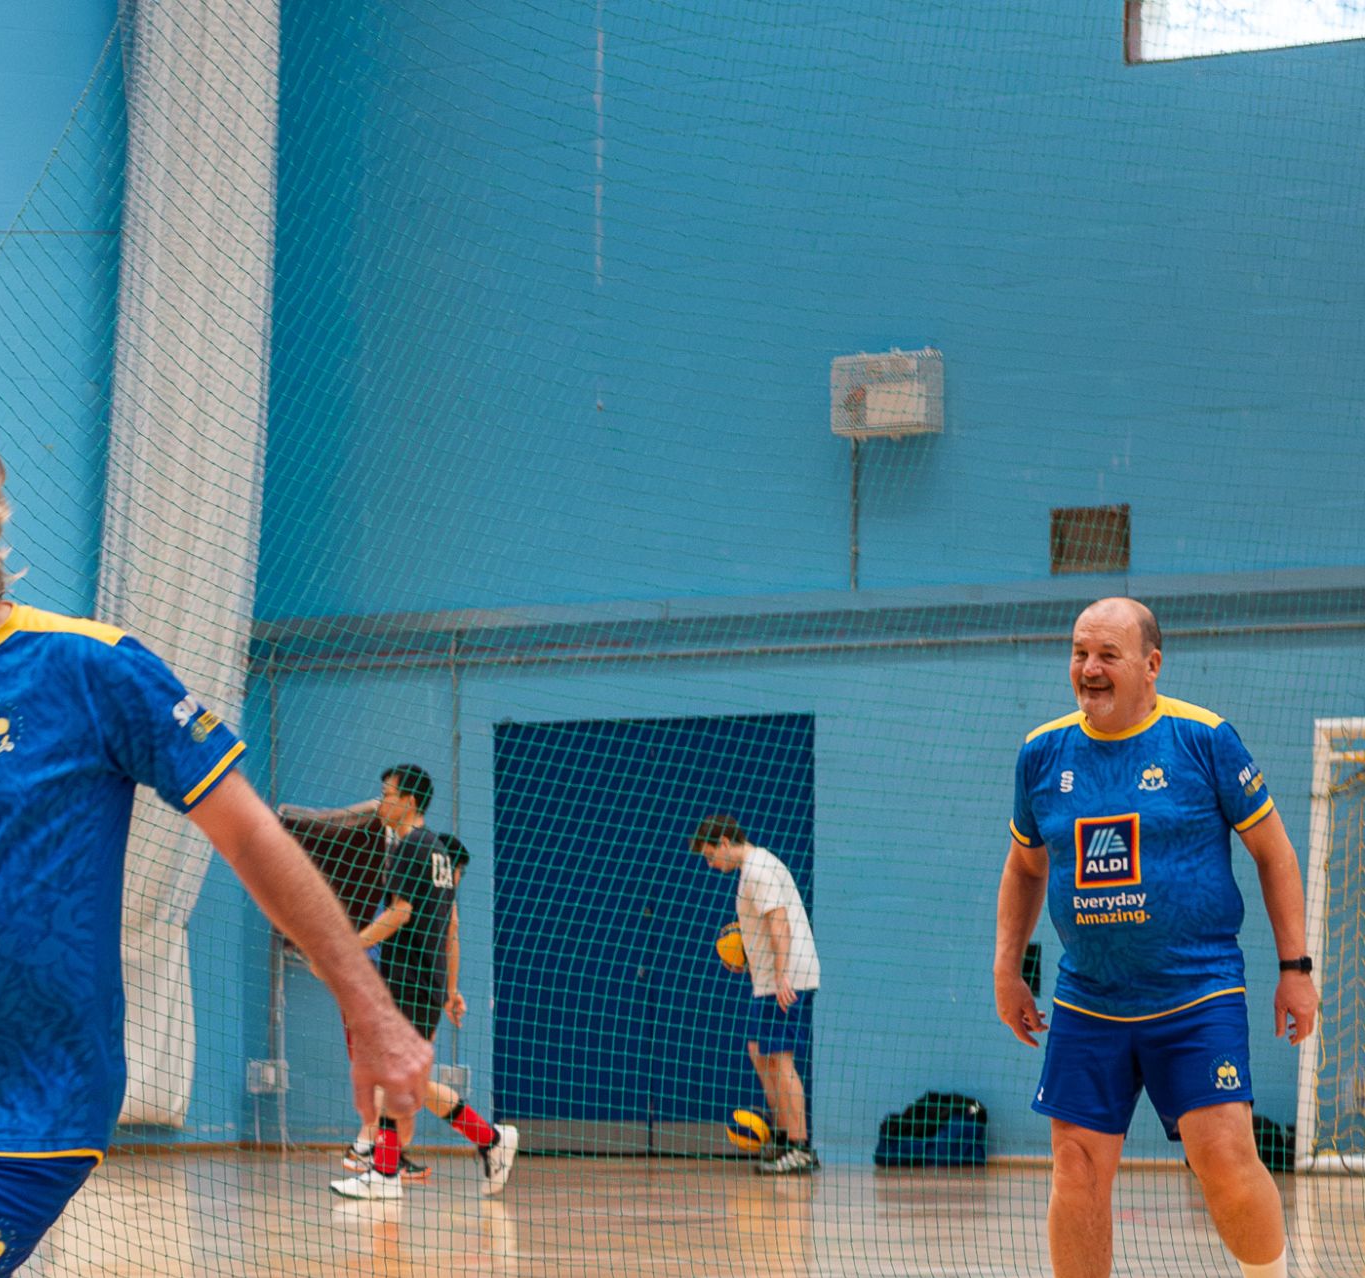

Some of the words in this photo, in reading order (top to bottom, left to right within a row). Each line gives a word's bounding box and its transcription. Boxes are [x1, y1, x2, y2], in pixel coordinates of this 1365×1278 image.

[1085, 857, 1129, 874] ALDI
[1073, 892, 1147, 910] Everyday
[1076, 908, 1151, 925] Amazing.
